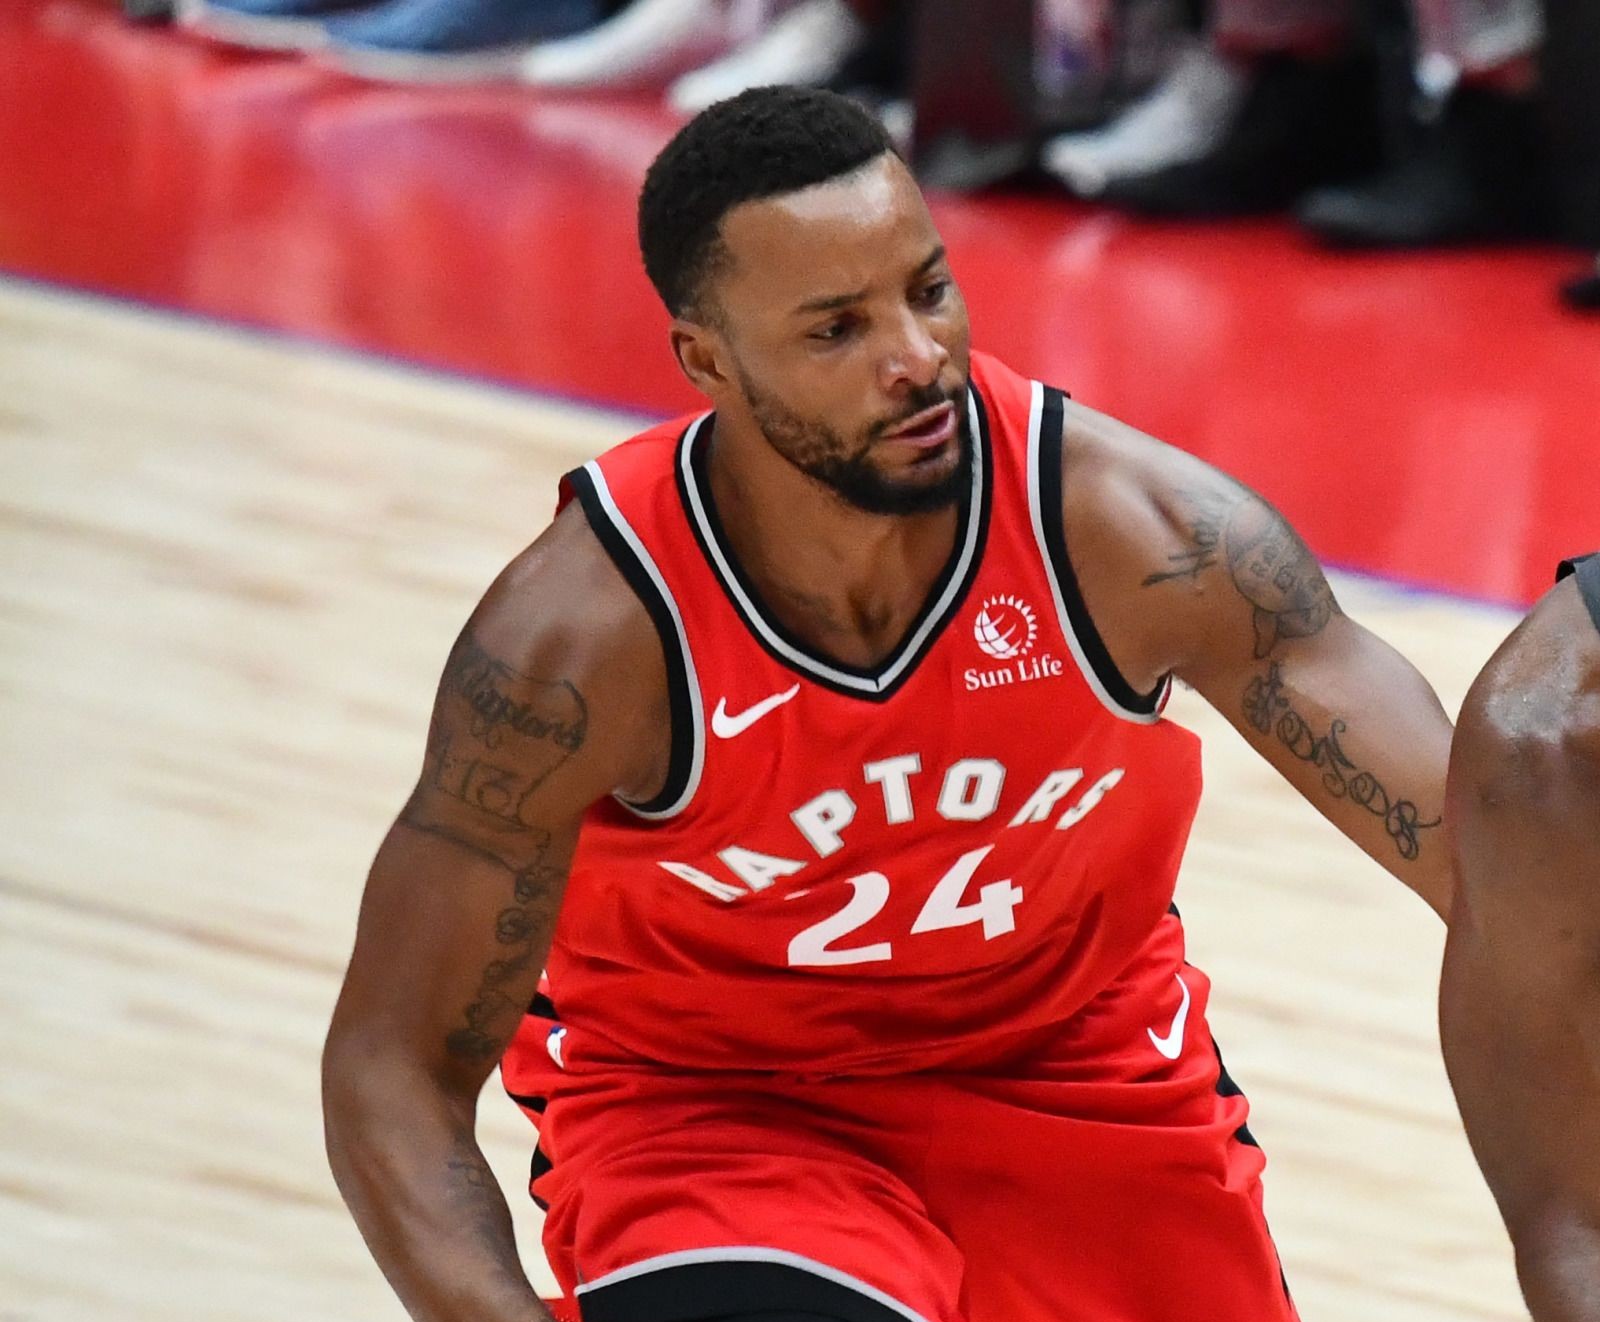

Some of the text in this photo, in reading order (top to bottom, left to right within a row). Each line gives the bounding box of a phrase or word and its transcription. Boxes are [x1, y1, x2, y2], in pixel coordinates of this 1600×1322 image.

[964, 653, 1064, 691] Sun Life
[785, 844, 1024, 966] 24
